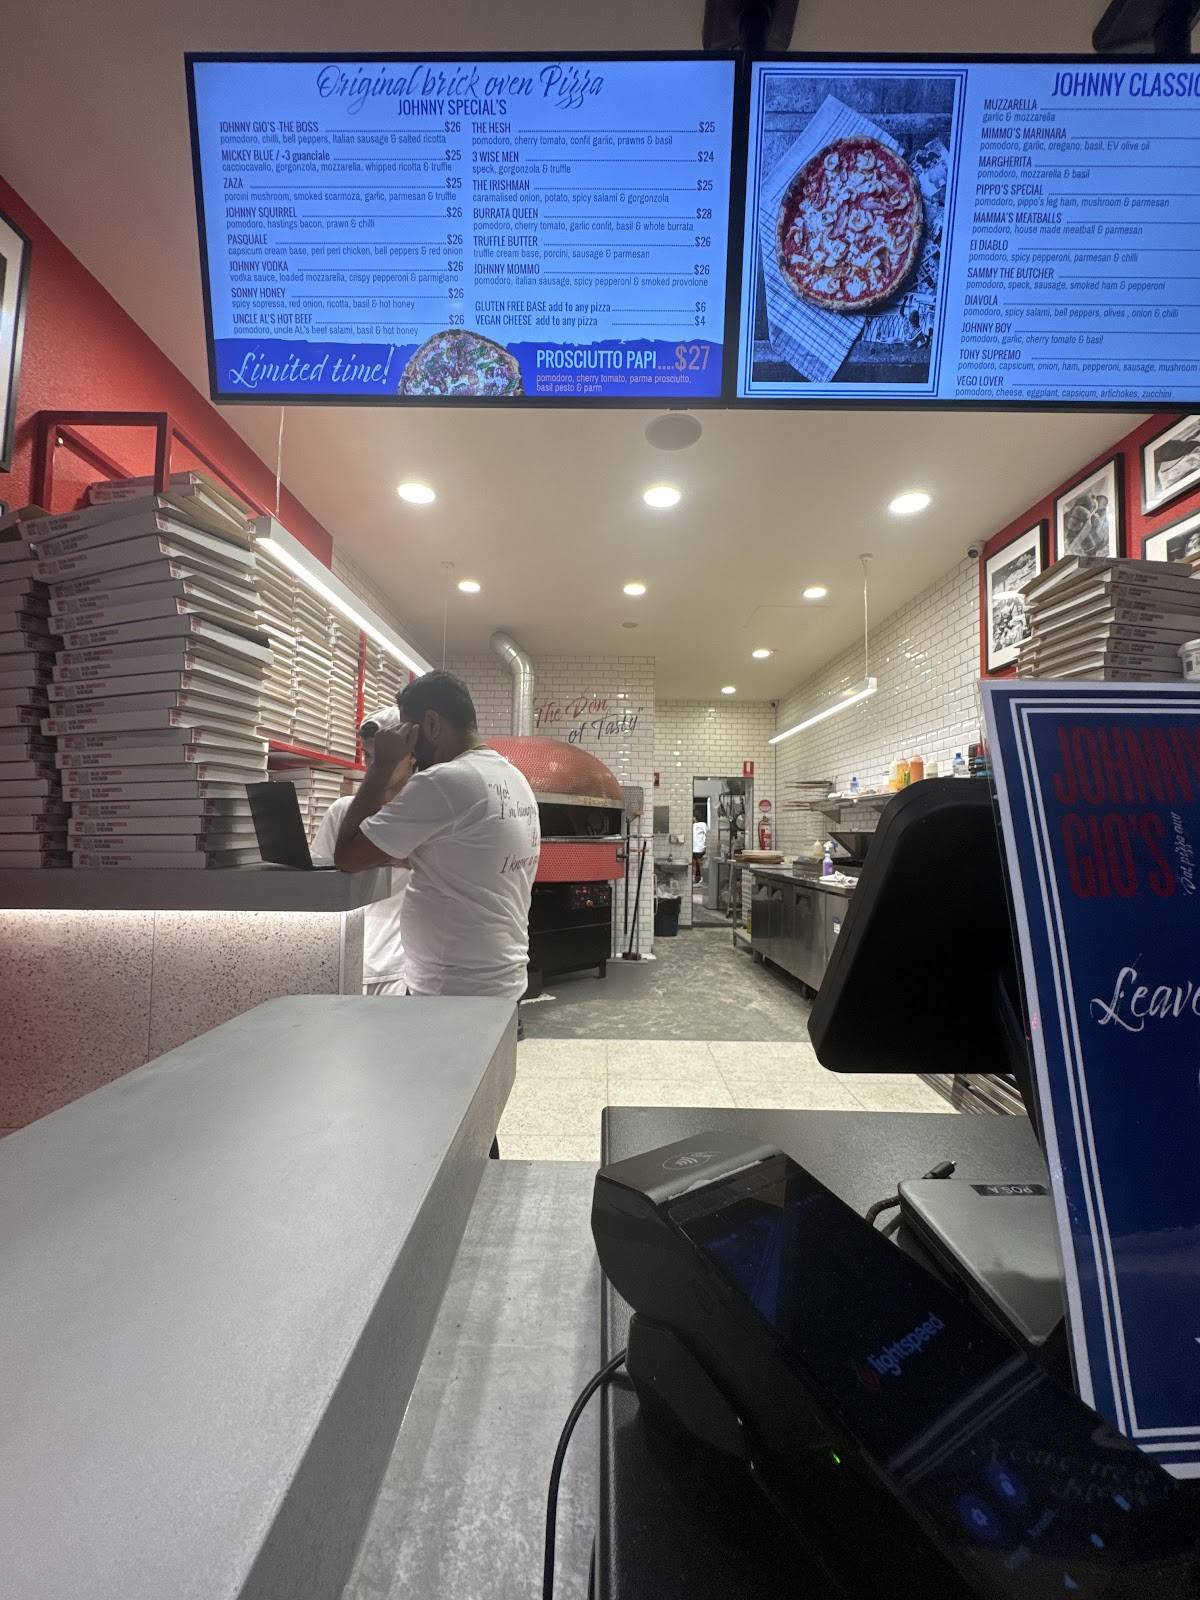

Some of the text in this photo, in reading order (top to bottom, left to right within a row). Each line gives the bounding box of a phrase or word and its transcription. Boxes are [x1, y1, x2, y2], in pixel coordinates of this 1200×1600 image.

[316, 64, 604, 116] Original brick oven Pizza
[1051, 71, 1126, 97] JOHNNY
[398, 98, 507, 116] JOHNNY SPECIAL'S
[983, 98, 1037, 111] MUZZARELLA
[219, 121, 251, 133] JOHNNY
[252, 121, 276, 133] GIO'S
[295, 121, 319, 133] BOSS
[444, 121, 461, 133] $26
[472, 121, 716, 133] THE HESH $25
[981, 128, 1067, 139] MIMMO'S MARINARA
[221, 149, 251, 161] MICKEY
[253, 149, 274, 161] BLUE
[292, 149, 330, 163] guanciale
[445, 150, 462, 161] $25
[472, 151, 714, 162] 3 WISE MEN $24
[978, 155, 1032, 168] MARGHERITA
[223, 178, 462, 189] ZAZA $25
[472, 179, 713, 192] THE IRISHMAN $25
[975, 184, 1043, 196] PIPPO'S SPECIAL
[225, 206, 463, 220] JOHNNY SQUIRREL $26
[473, 208, 713, 220] BURRATA QUEEN $28
[973, 212, 1062, 224] MAMMA'S MEATBALLS
[227, 234, 463, 247] PASQUALE $26
[473, 235, 711, 248] TRUFFLE BUTTER $26
[979, 239, 1008, 251] DIABLO
[229, 260, 464, 272] JOHNNY VODKA $26
[474, 264, 710, 275] JOHNNY MOMMO $26
[967, 267, 1055, 279] SAMMY THE BUTCHER
[231, 287, 464, 299] SONNY HONEY $26
[964, 294, 998, 306] DIAVOLA
[475, 300, 706, 314] GLUTEN FREE BASE add to any pizza $6
[232, 313, 465, 326] UNCLE AL'S HOT BEEF $26
[475, 315, 706, 328] VEGAN CHEESE add to any pizza $4
[961, 322, 1012, 334] JOHNNY BOY
[535, 349, 623, 369] PROSCIUTTO
[959, 349, 1021, 360] TONY SUPREMO
[229, 346, 395, 389] Limited time!
[956, 375, 1004, 387] VEGO LOVER
[1061, 812, 1176, 897] GIO'S
[1089, 965, 1200, 1032] Leave
[867, 1311, 945, 1376] lightspeed
